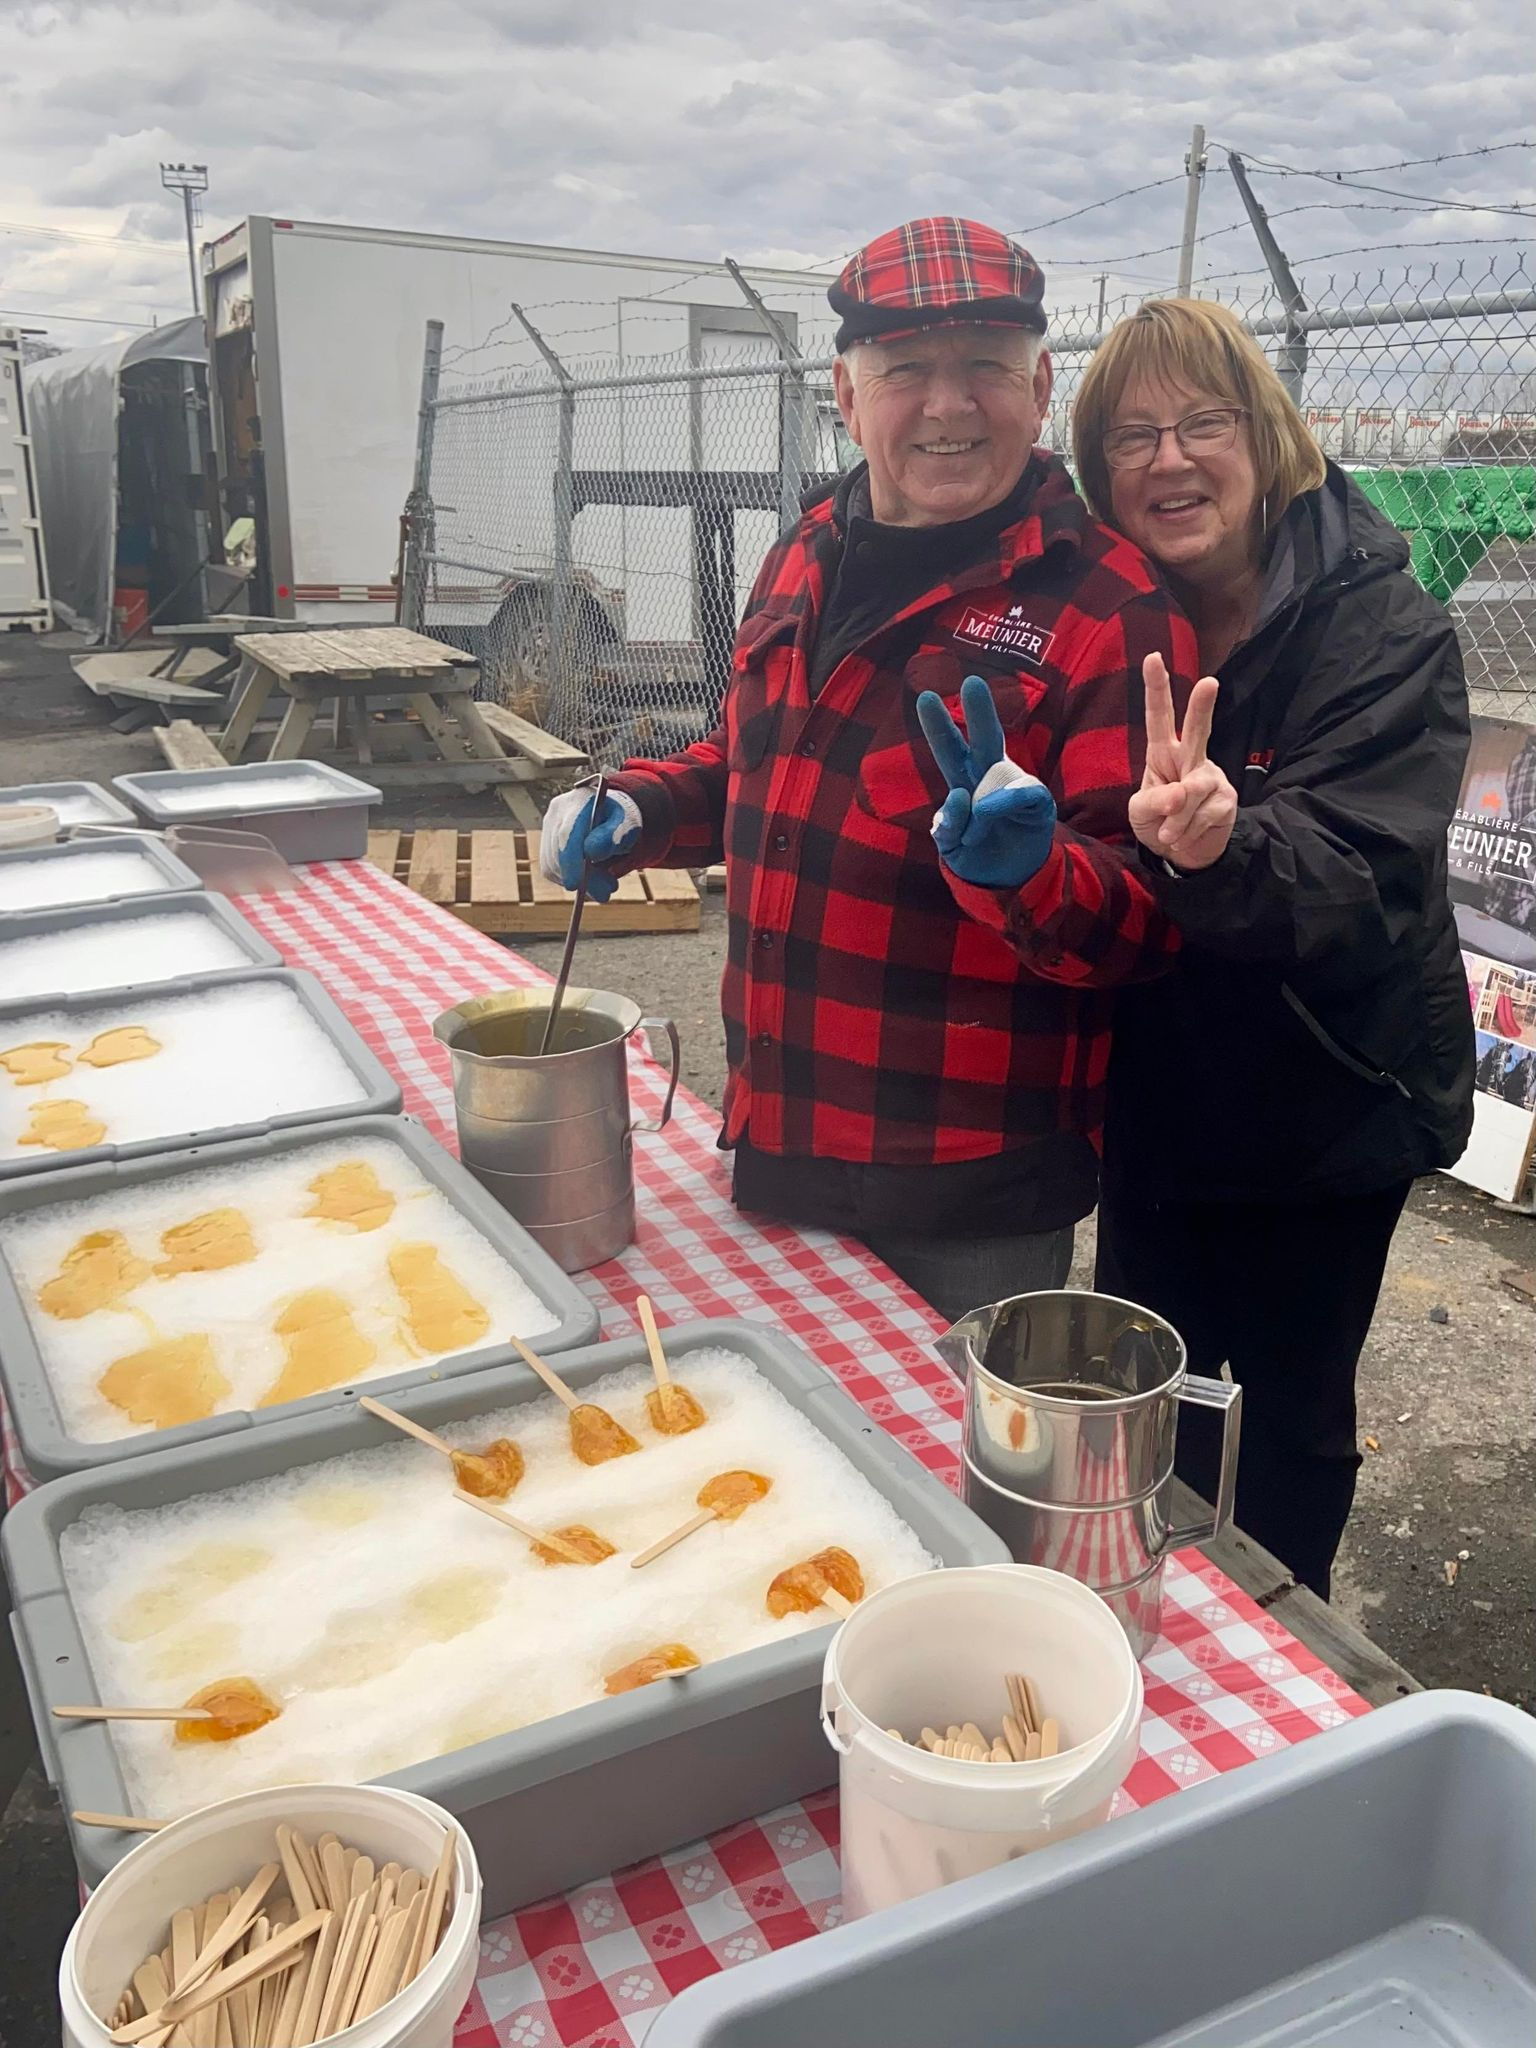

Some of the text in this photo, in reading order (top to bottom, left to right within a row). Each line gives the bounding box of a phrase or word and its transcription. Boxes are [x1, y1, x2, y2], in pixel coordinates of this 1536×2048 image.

[965, 617, 1042, 654] MEUNIER
[1455, 807, 1519, 832] ÉRABLIÈRE
[1447, 824, 1532, 869] EUNIER
[1455, 858, 1493, 875] & FILS
